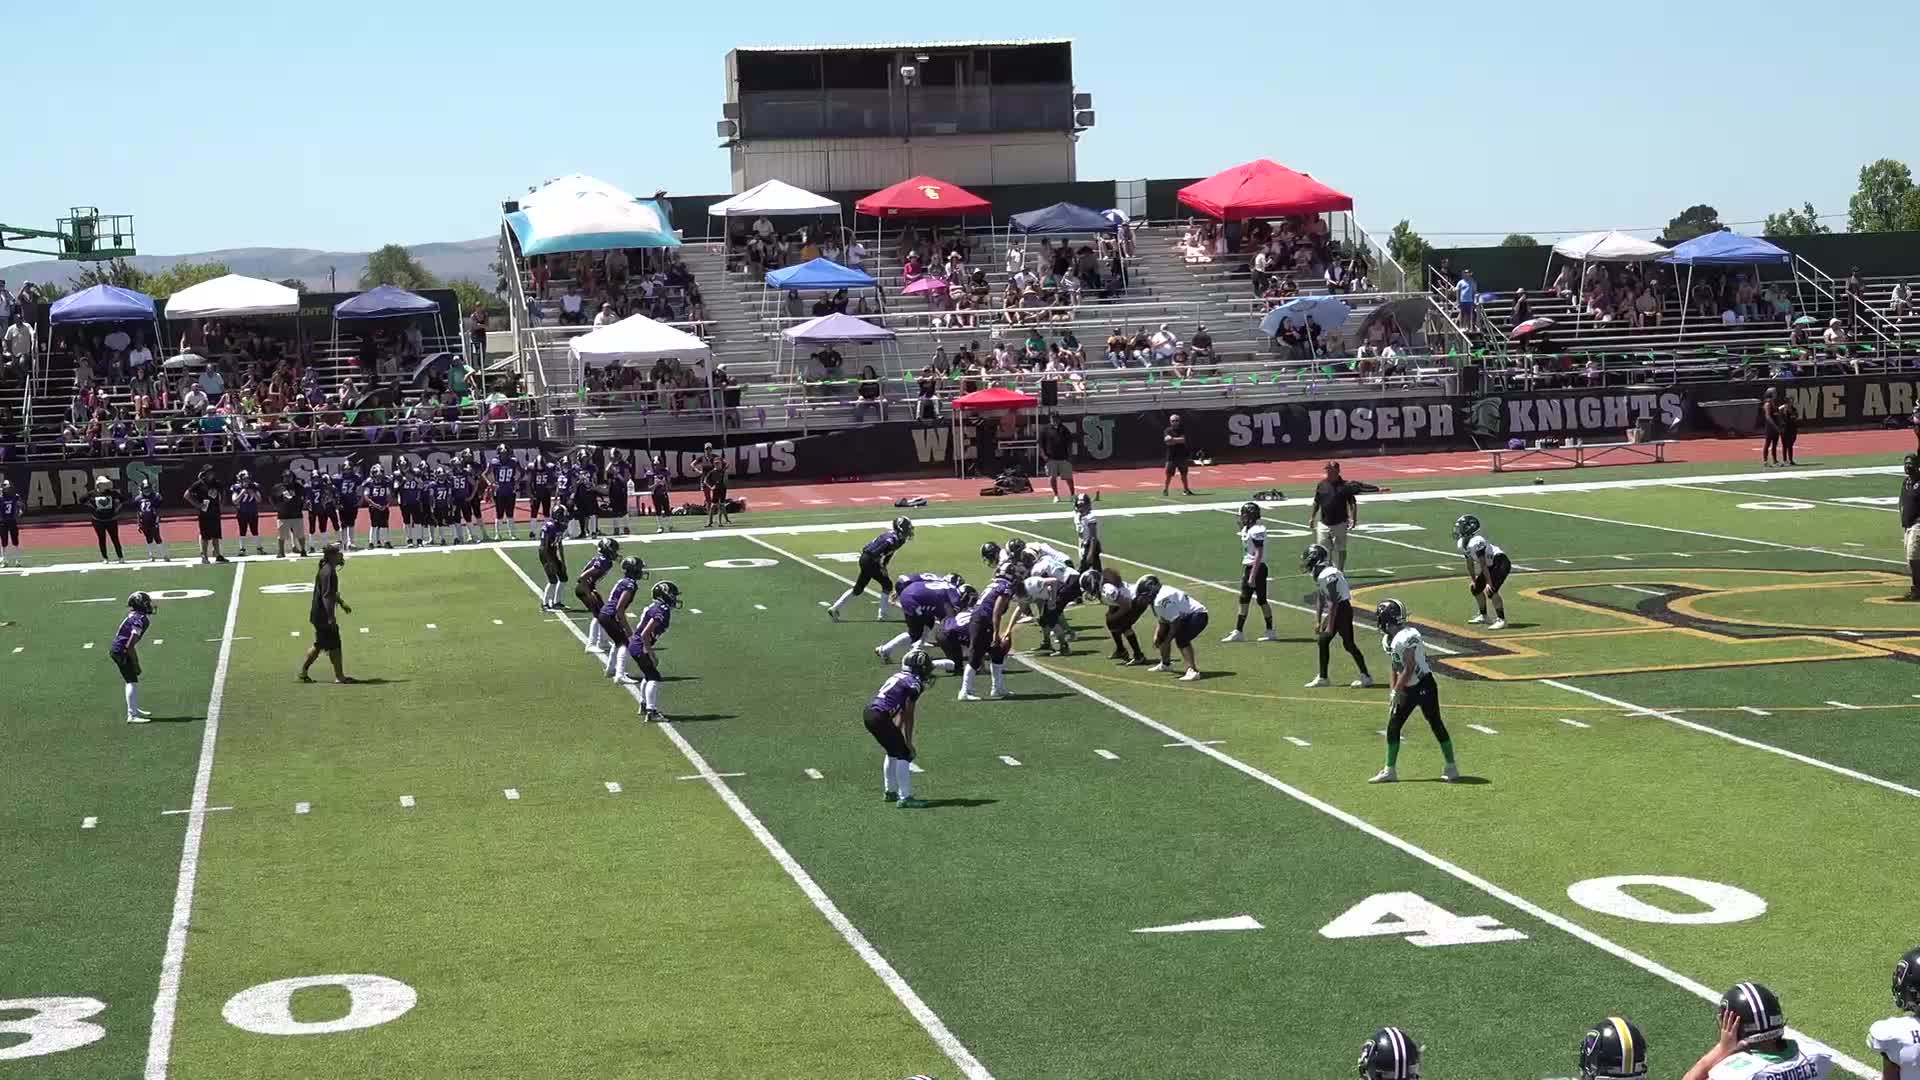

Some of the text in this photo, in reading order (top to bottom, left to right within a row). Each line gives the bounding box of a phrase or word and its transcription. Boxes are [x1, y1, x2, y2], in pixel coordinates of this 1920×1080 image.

[1508, 392, 1684, 433] KNIGHTS
[1786, 381, 1920, 420] WE AR
[1228, 404, 1455, 447] ST. JOSEPH
